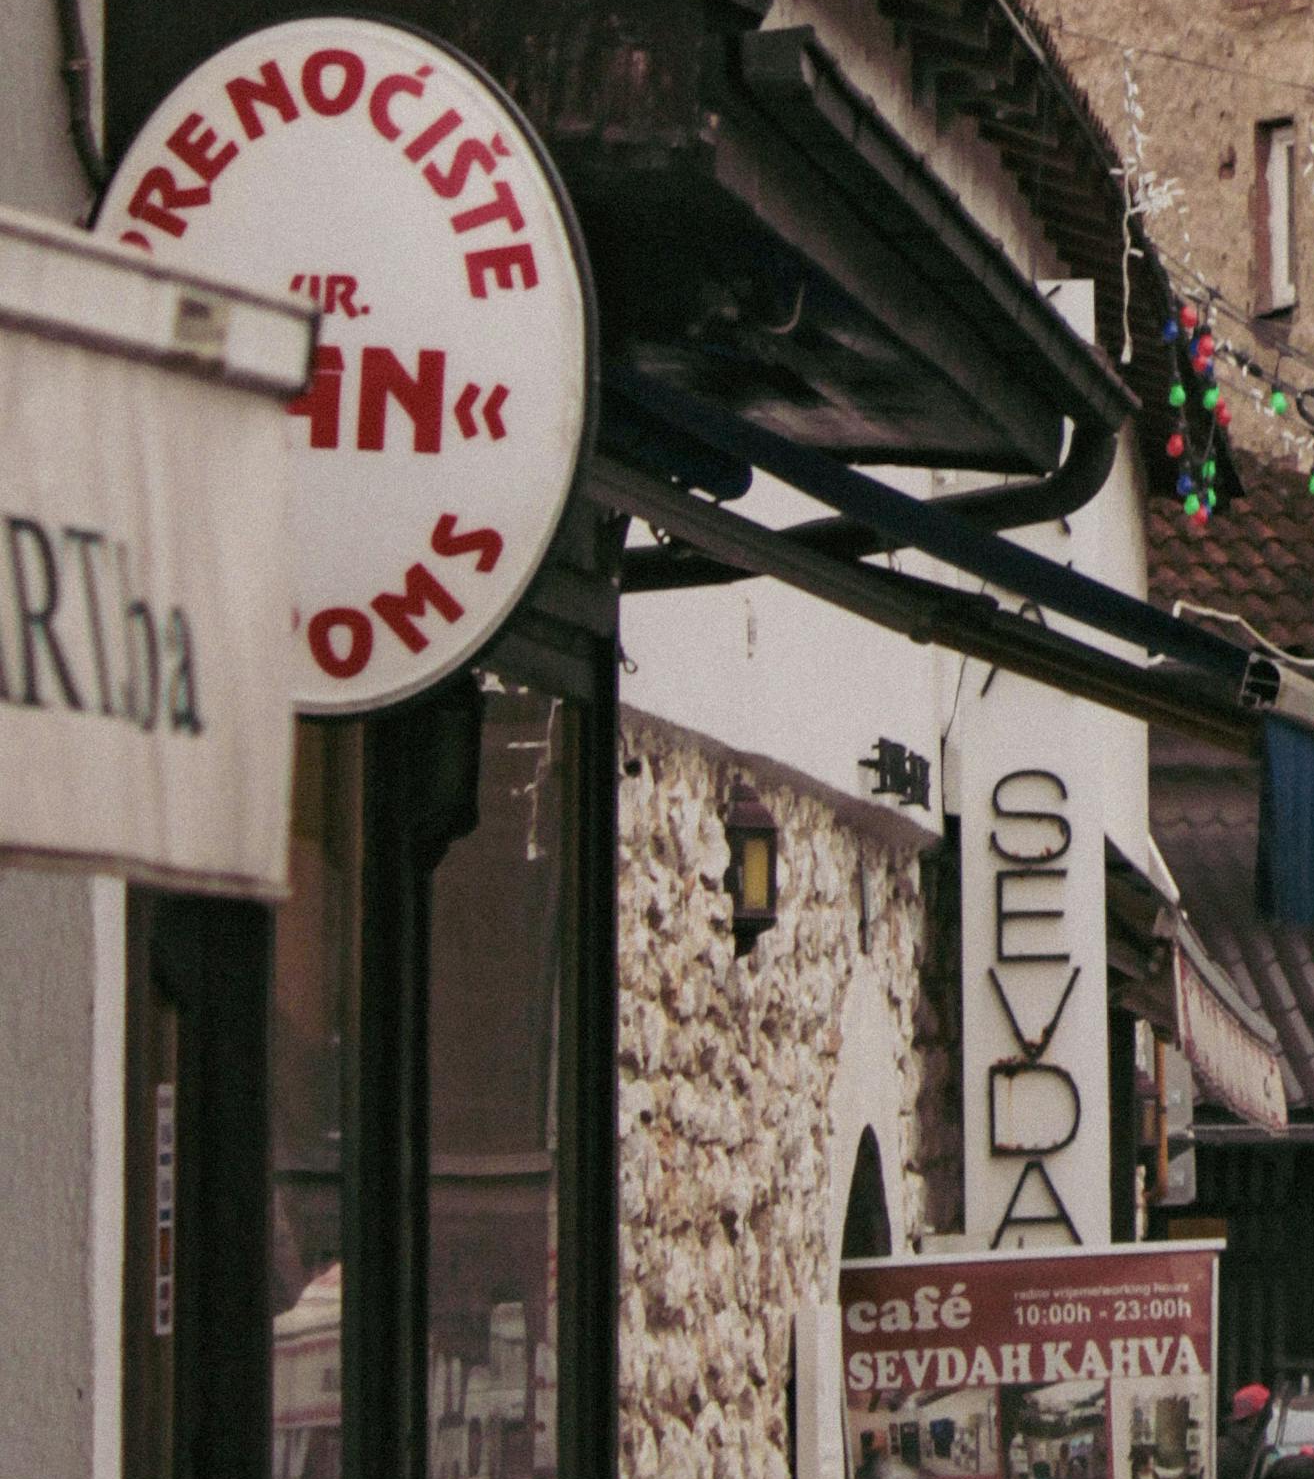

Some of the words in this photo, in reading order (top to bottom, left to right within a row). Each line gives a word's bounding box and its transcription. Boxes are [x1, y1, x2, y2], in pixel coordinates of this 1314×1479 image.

[120, 47, 540, 301] RENOĆIŠTE
[305, 513, 504, 680] OMS
[846, 1282, 972, 1334] café
[1014, 1301, 1091, 1326] 10:00h
[1113, 1297, 1192, 1322] 23:00h
[849, 1343, 1032, 1391] SEVDAH
[1042, 1334, 1207, 1381] KAHVA
